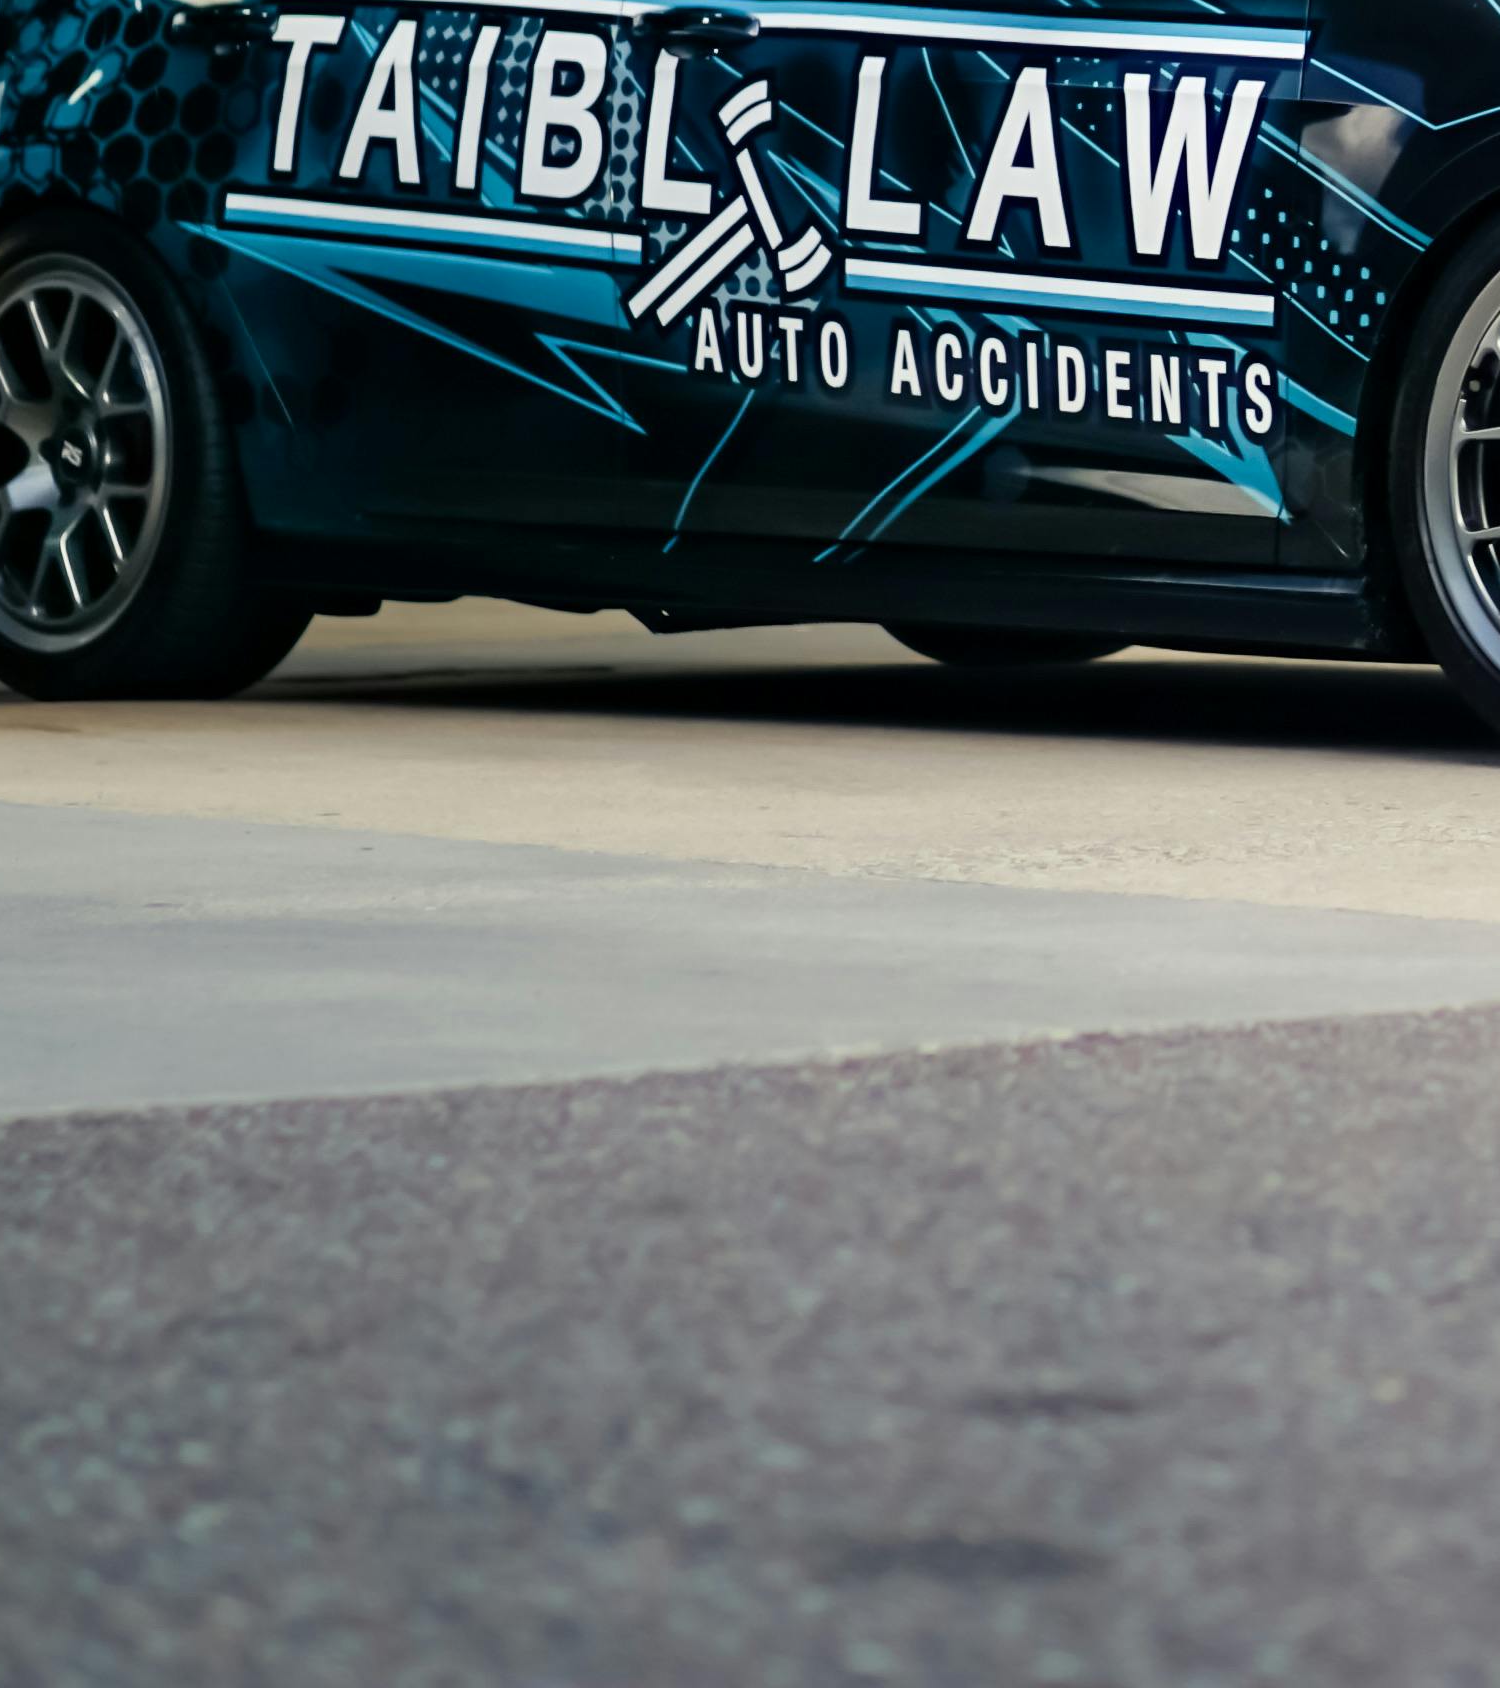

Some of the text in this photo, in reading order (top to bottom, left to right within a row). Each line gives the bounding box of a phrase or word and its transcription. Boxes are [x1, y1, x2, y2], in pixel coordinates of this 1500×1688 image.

[271, 13, 1266, 260] TAIBL LAW
[695, 307, 1273, 433] AUTO ACCIDENTS
